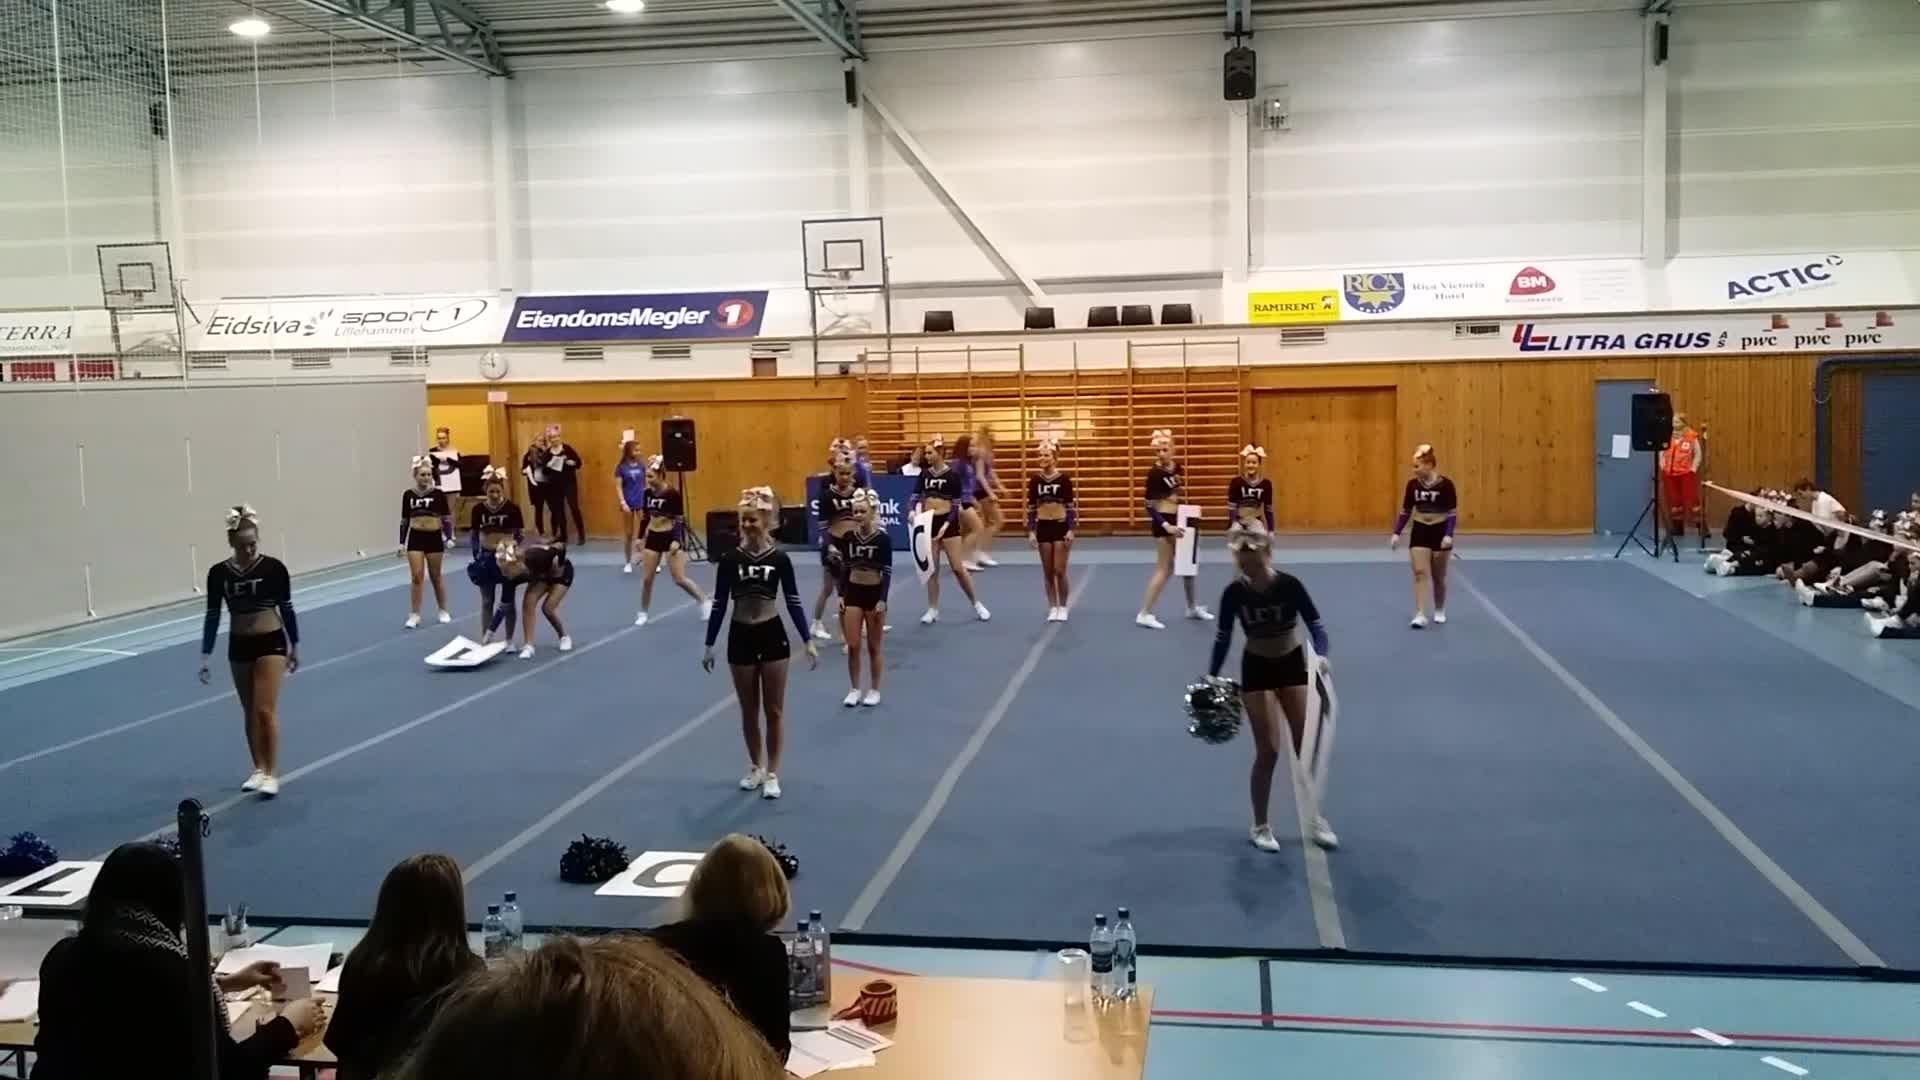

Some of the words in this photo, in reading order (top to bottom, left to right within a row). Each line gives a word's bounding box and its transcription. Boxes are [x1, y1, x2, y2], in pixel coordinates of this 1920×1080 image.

[1346, 273, 1404, 291] RICA
[1517, 275, 1547, 289] BM
[1728, 263, 1831, 299] ACTIC
[1254, 302, 1317, 312] RAMIRENT
[207, 315, 301, 335] Eidsiva
[341, 308, 439, 326] sport
[517, 306, 710, 330] EiendomsMegler
[724, 303, 743, 326] 1
[1634, 332, 1711, 349] GRUS
[1741, 335, 1777, 350] pwc
[1795, 334, 1831, 349] pwc
[1845, 333, 1883, 348] pwc
[913, 525, 929, 571] C
[8, 867, 86, 898] L
